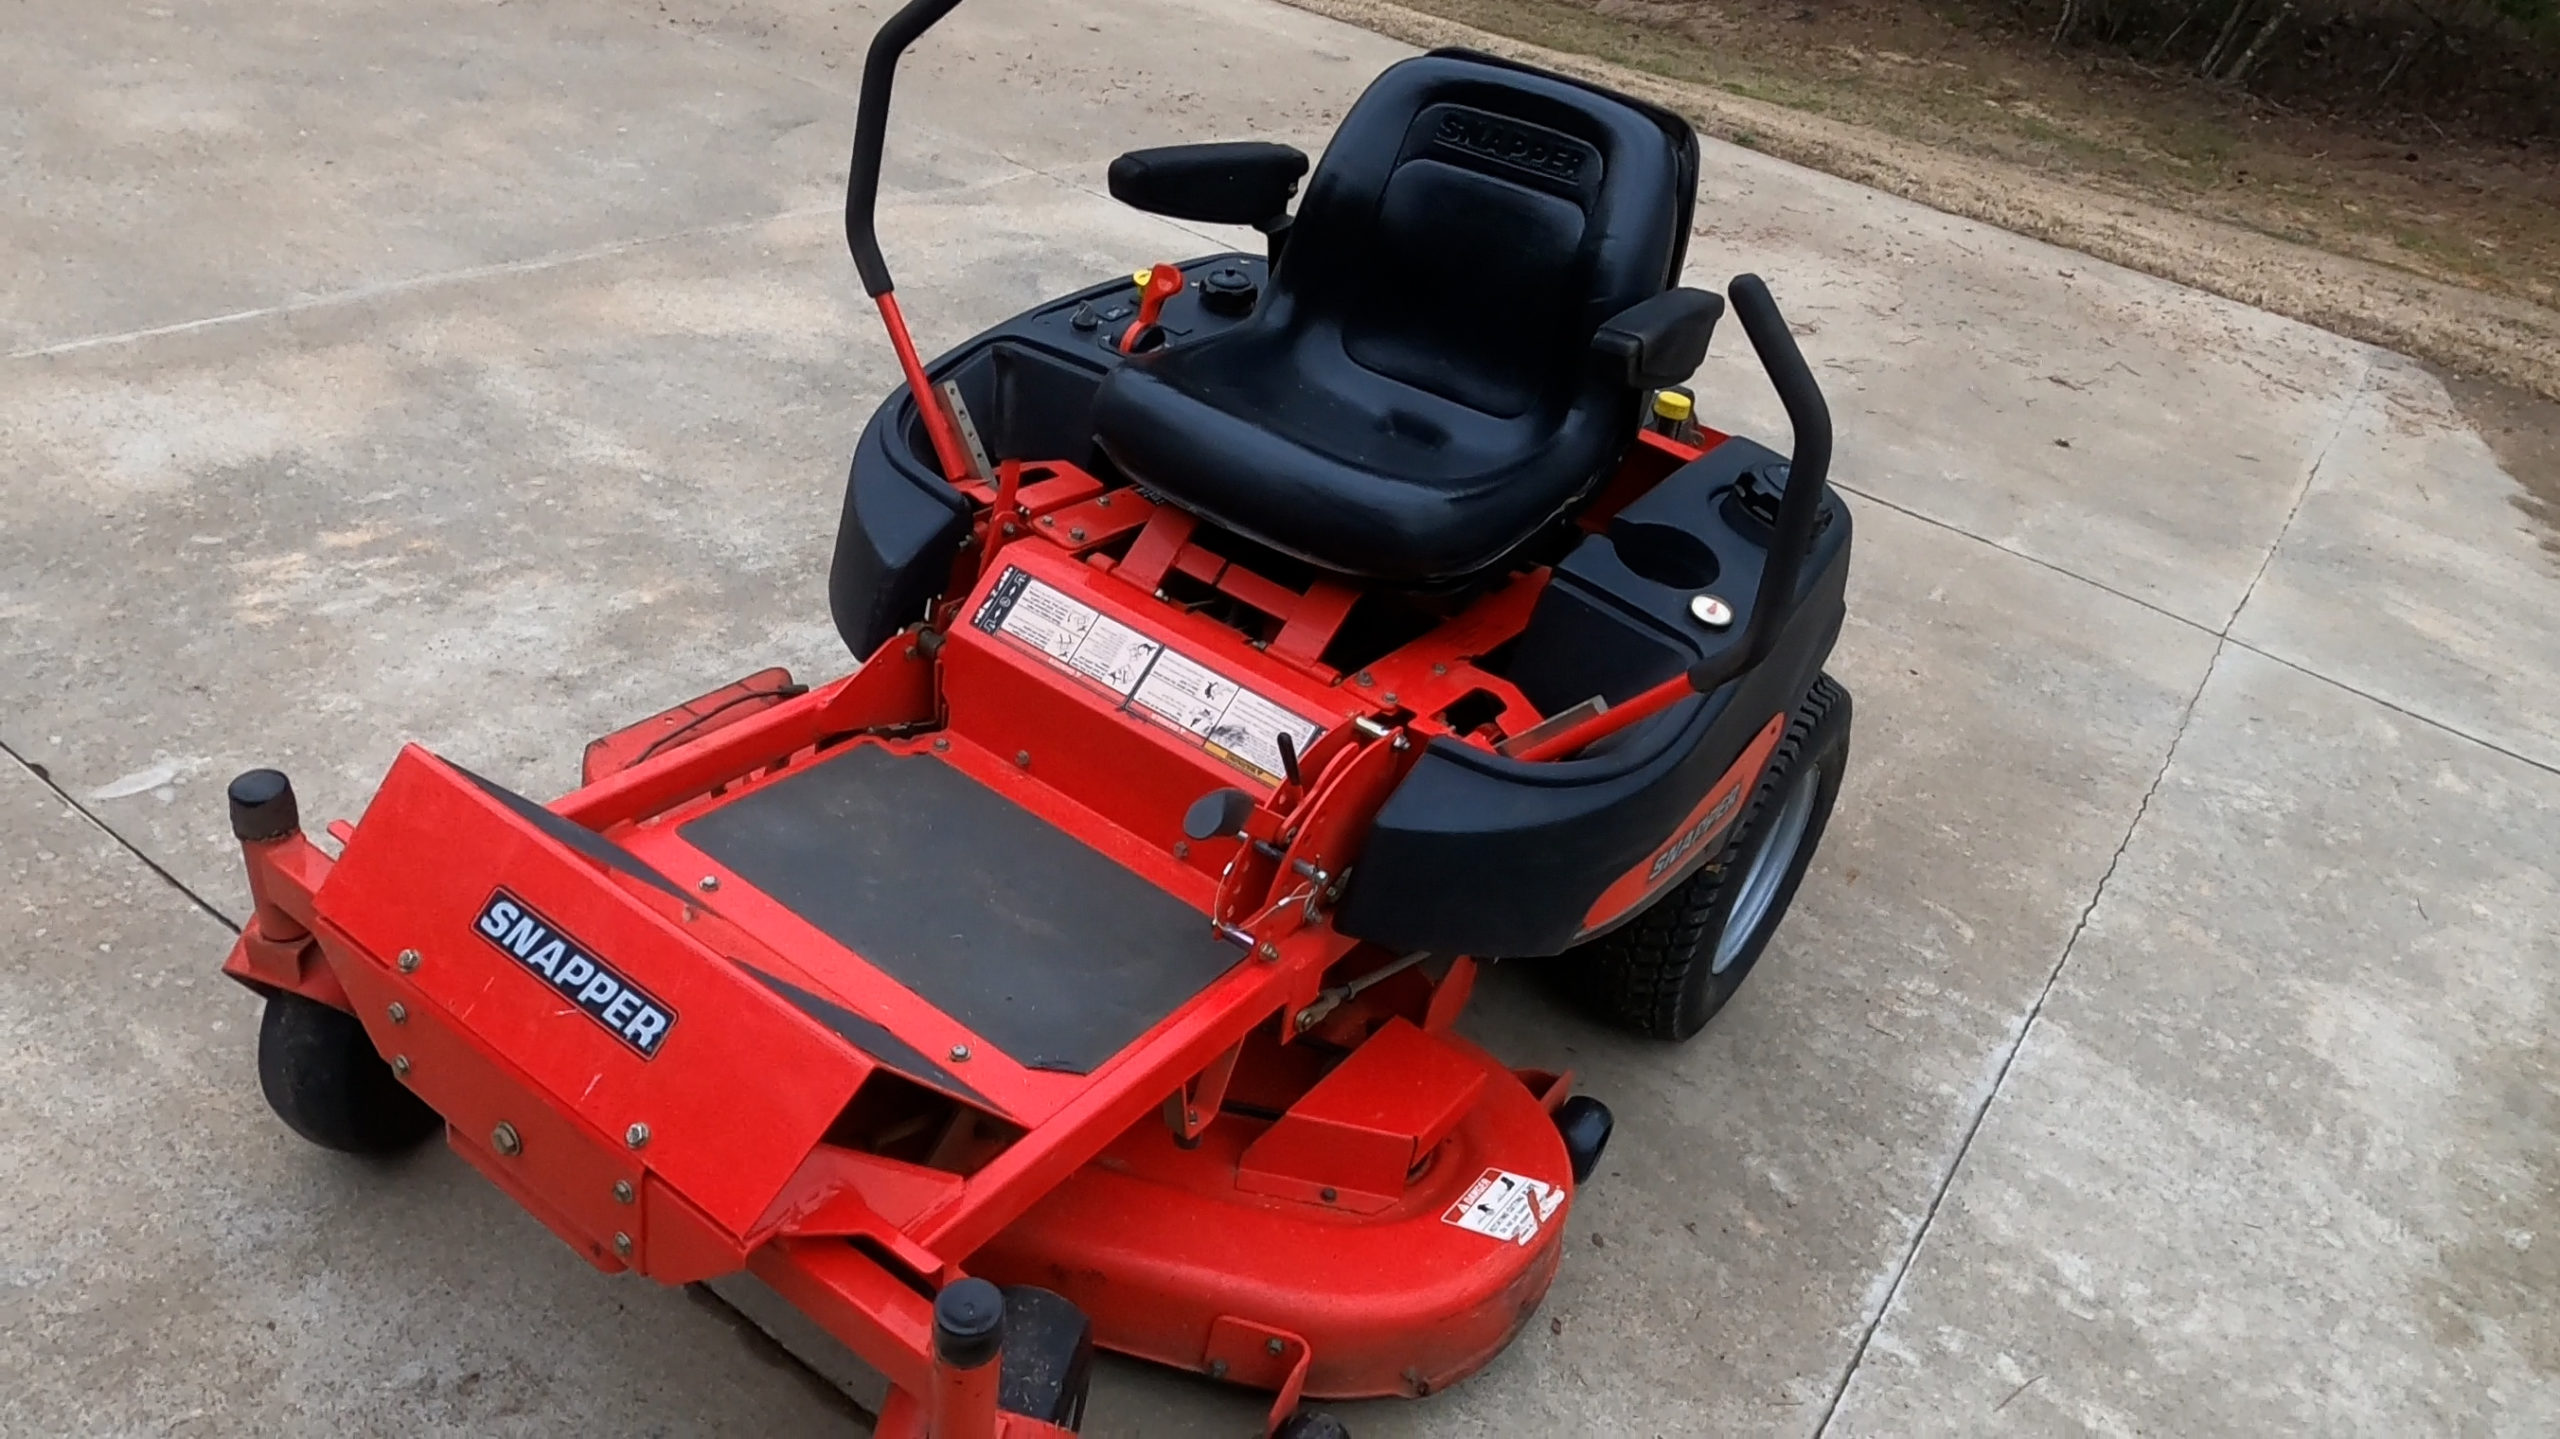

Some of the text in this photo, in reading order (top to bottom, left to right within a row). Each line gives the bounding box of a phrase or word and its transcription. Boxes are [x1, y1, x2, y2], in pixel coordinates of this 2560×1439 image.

[1435, 113, 1586, 179] SNAPPER
[1649, 783, 1742, 881] SNAPPER
[480, 901, 667, 1049] SNAPPER
[1463, 1178, 1491, 1206] DANGER
